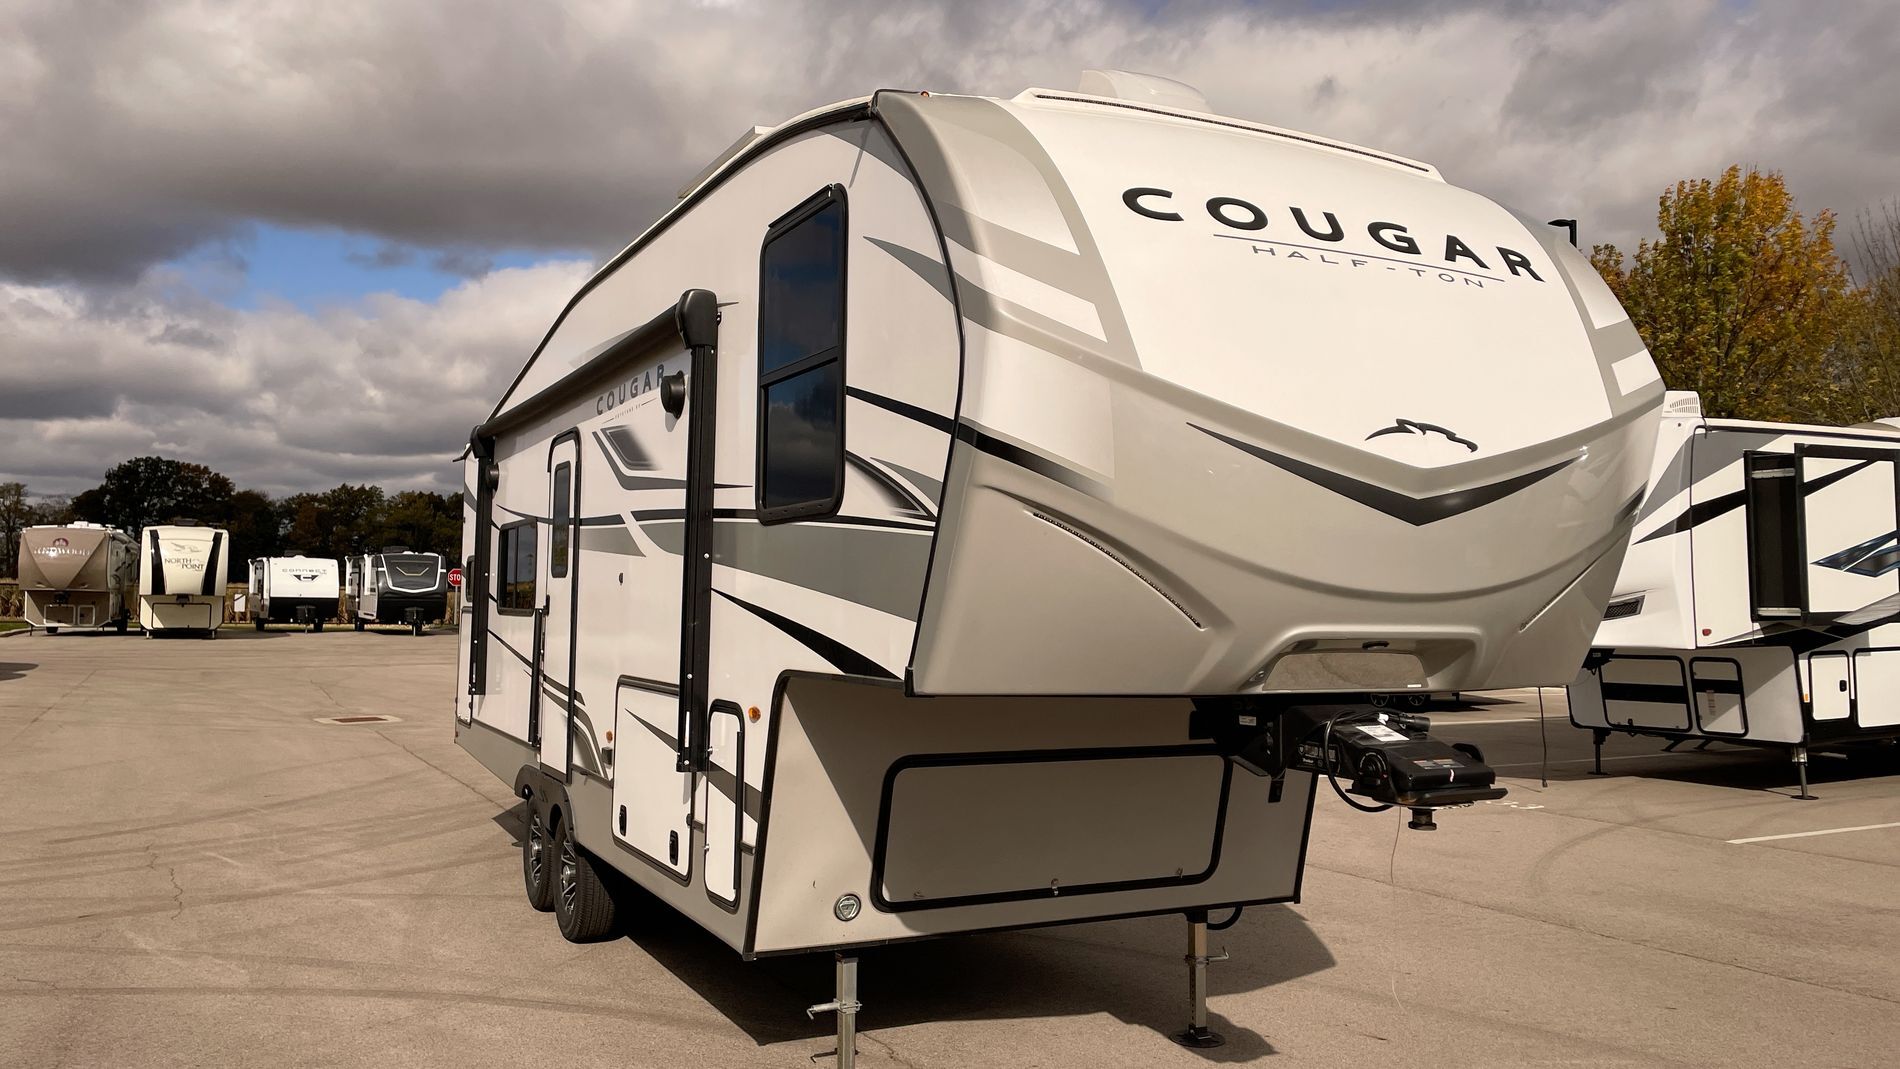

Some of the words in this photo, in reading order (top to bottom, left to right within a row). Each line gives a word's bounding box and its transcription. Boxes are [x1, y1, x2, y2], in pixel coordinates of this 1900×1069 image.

[1121, 186, 1546, 283] COUGAR
[1252, 245, 1485, 289] HALF-TON
[597, 364, 665, 415] COUGAR
[449, 573, 461, 582] STO
